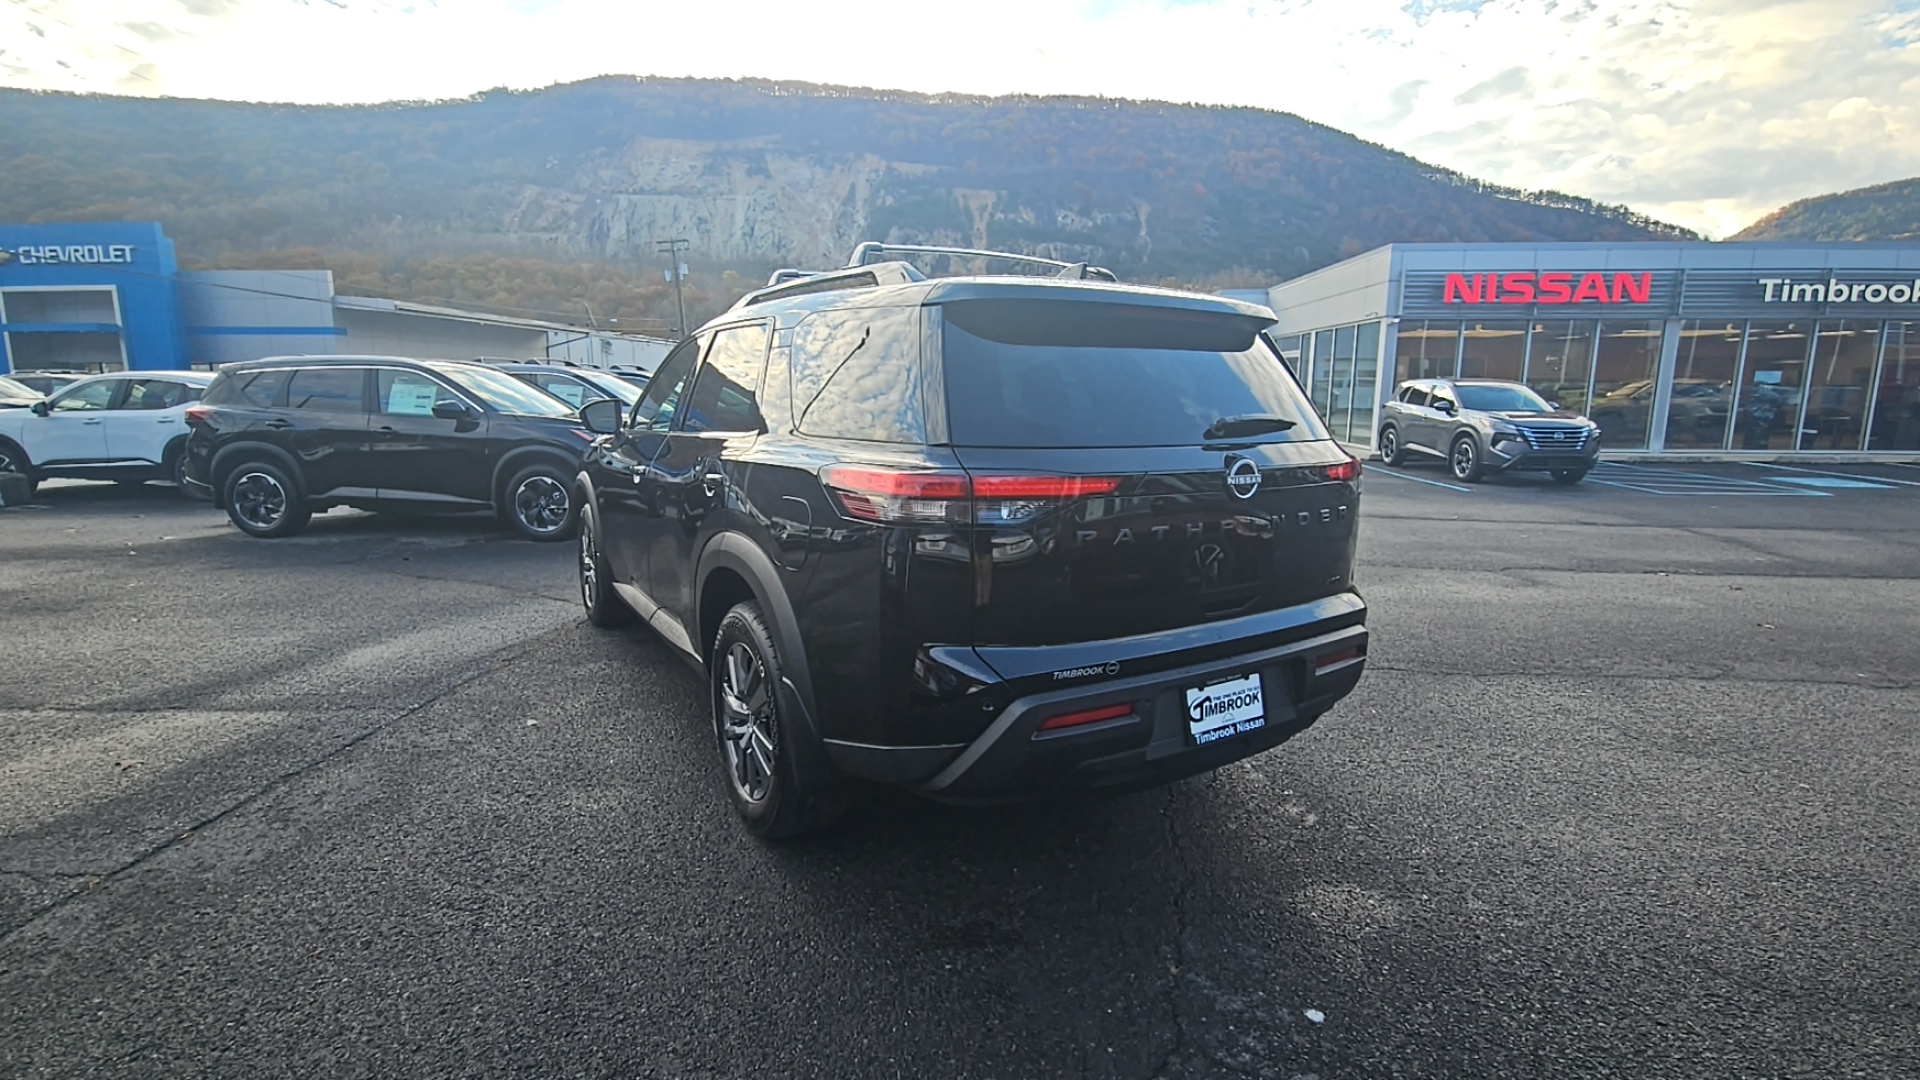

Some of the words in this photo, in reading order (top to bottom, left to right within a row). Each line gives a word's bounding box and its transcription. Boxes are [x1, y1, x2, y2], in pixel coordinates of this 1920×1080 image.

[18, 244, 134, 264] CHEVROLET
[1443, 272, 1652, 304] NISSAN
[1227, 474, 1262, 485] NISSAN
[1077, 505, 1348, 546] PATHFNDER
[1053, 665, 1105, 680] TIMBROOK
[1190, 691, 1260, 723] TIMBROOK
[1194, 724, 1236, 745] Timbrook
[1236, 718, 1265, 733] Nissan
